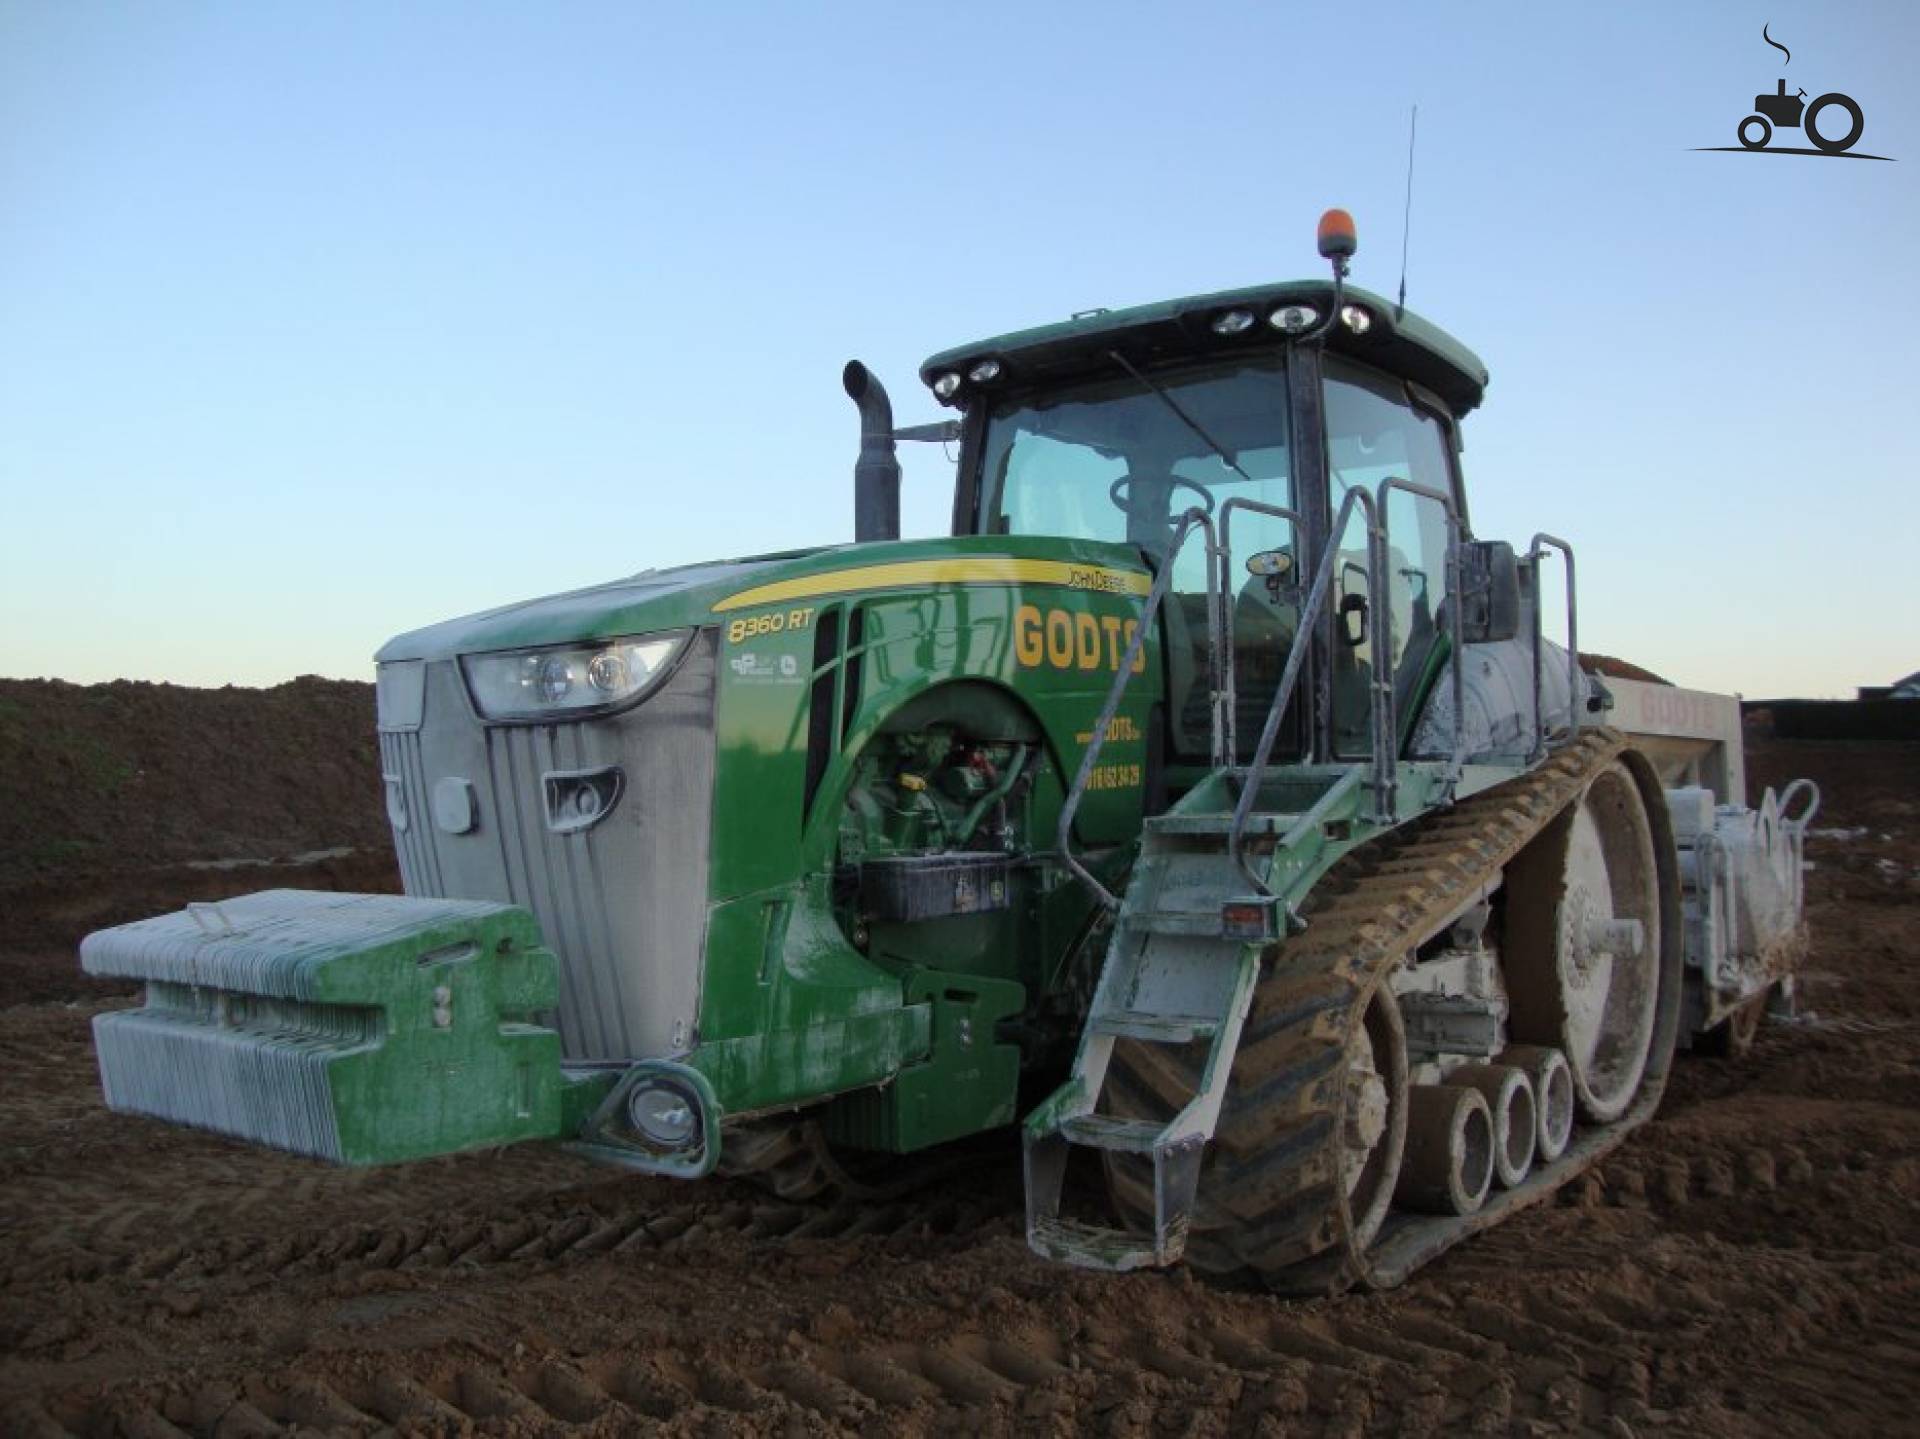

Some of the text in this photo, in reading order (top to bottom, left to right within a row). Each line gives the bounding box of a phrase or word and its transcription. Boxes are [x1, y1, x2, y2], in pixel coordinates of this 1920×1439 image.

[729, 607, 816, 643] 8360 RT
[1015, 605, 1147, 673] GODTS
